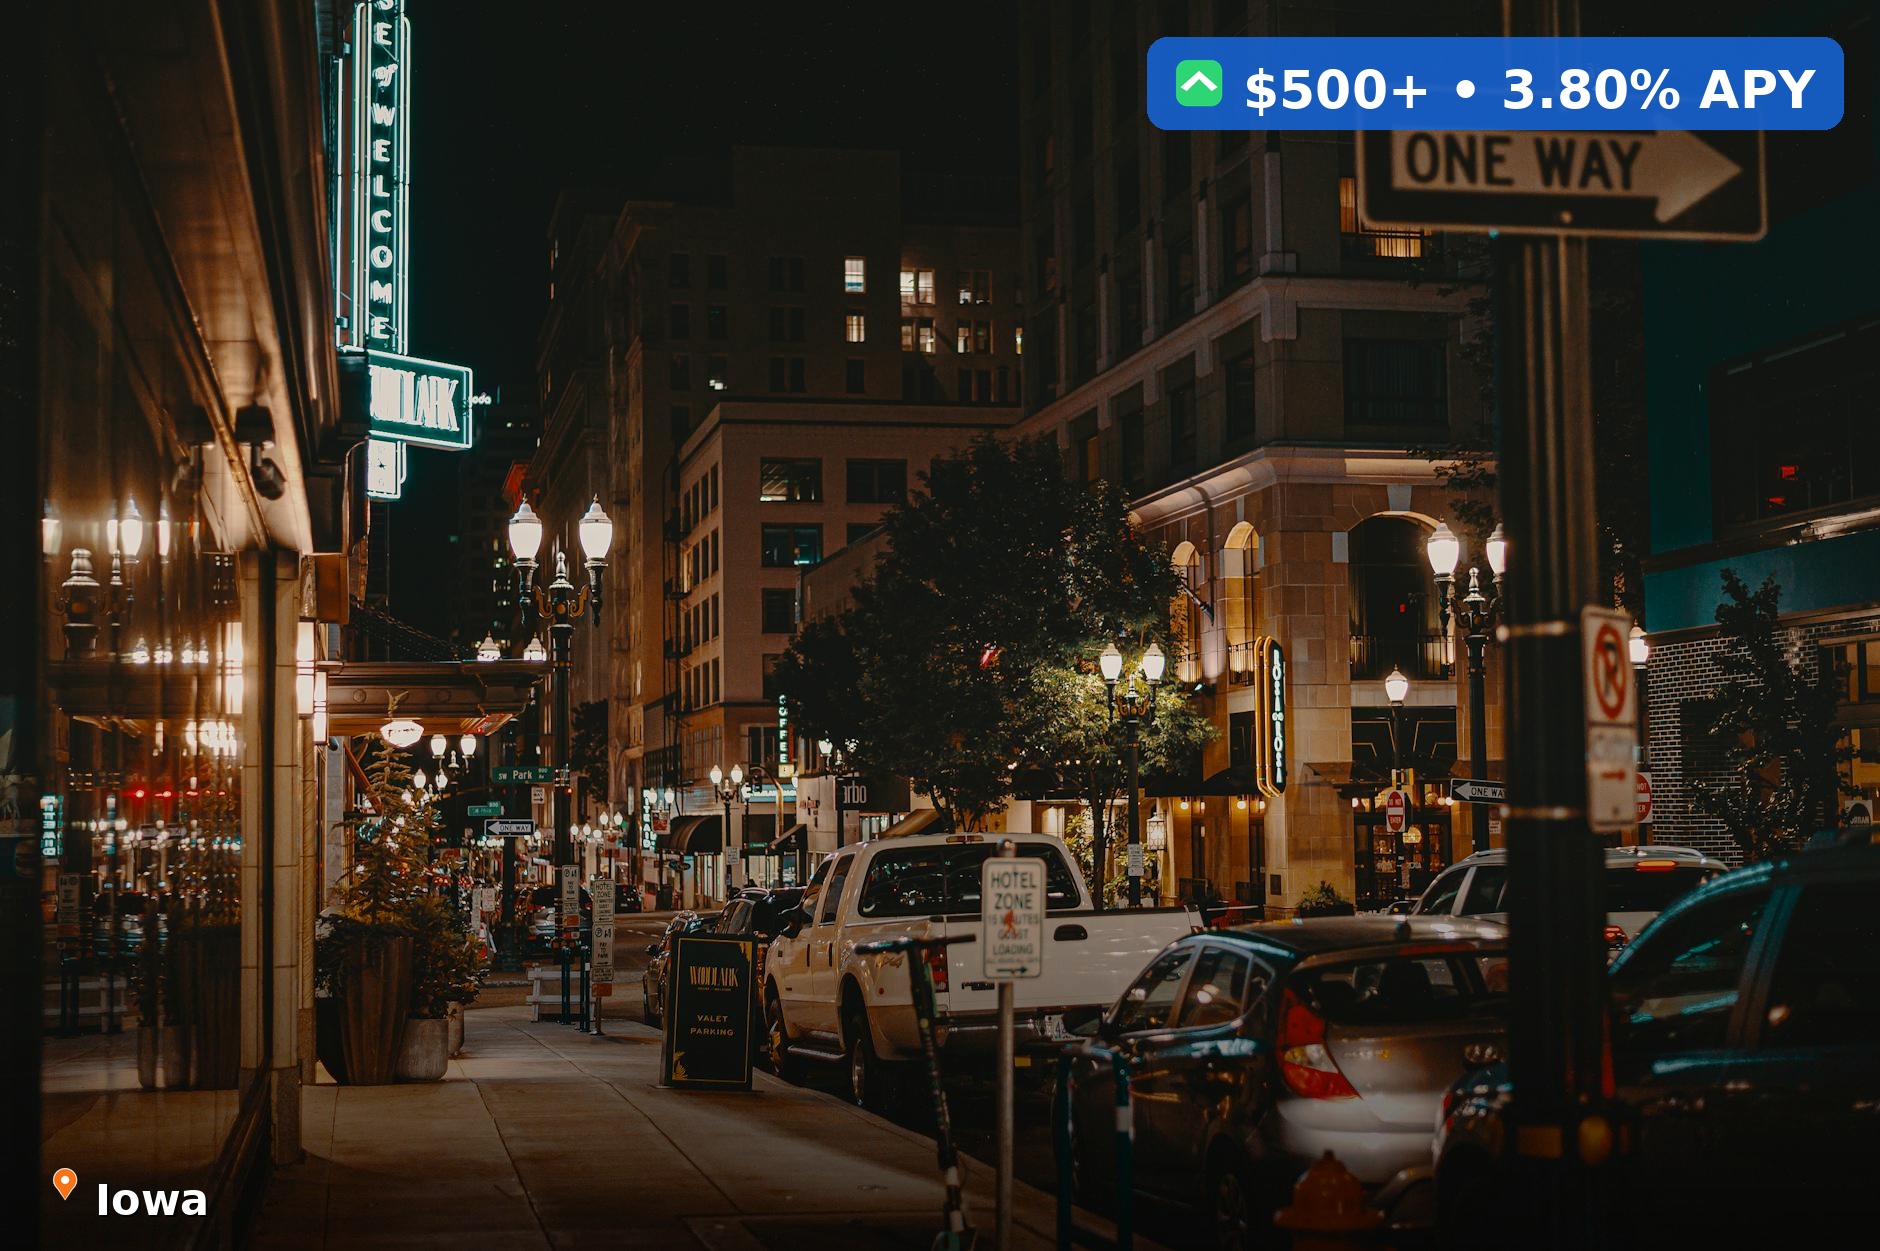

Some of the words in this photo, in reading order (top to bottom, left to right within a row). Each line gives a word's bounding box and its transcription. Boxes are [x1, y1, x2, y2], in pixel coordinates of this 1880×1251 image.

[372, 63, 398, 88] of
[1406, 132, 1513, 187] ONE
[1534, 139, 1642, 190] WAY
[370, 102, 396, 339] WELCOME
[778, 694, 788, 763] COFFEE
[498, 772, 508, 780] SW
[512, 769, 533, 780] Park
[1471, 787, 1488, 797] ONE
[500, 823, 512, 832] ONE
[516, 824, 530, 832] WAY
[991, 871, 1037, 889] HOTEL
[595, 883, 613, 891] HOTEL
[994, 893, 1033, 910] ZONE
[993, 944, 1033, 956] LOADING
[697, 1014, 729, 1024] VALET
[690, 1027, 735, 1037] PARKING
